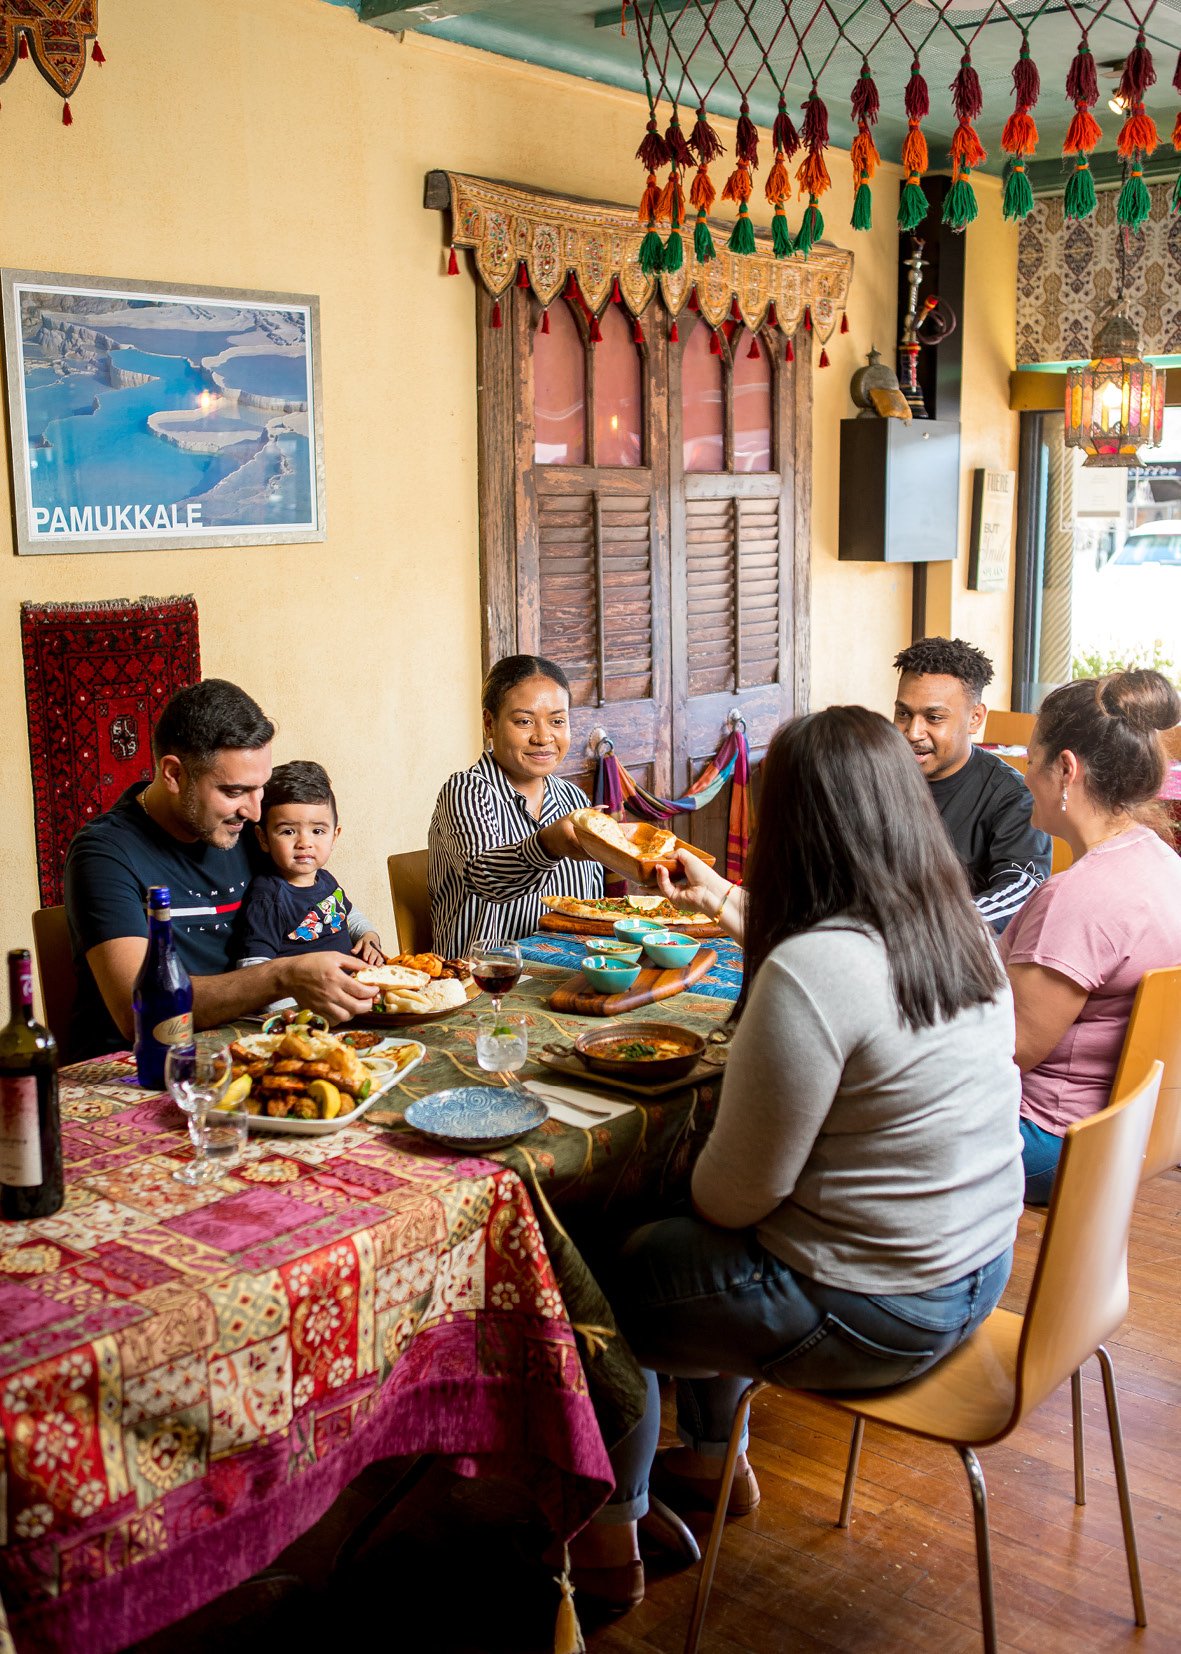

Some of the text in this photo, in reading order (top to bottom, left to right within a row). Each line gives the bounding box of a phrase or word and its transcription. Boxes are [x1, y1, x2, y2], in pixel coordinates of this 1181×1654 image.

[987, 472, 1009, 493] THERE
[31, 503, 202, 533] PAMUKKALE
[984, 522, 1001, 534] BUT
